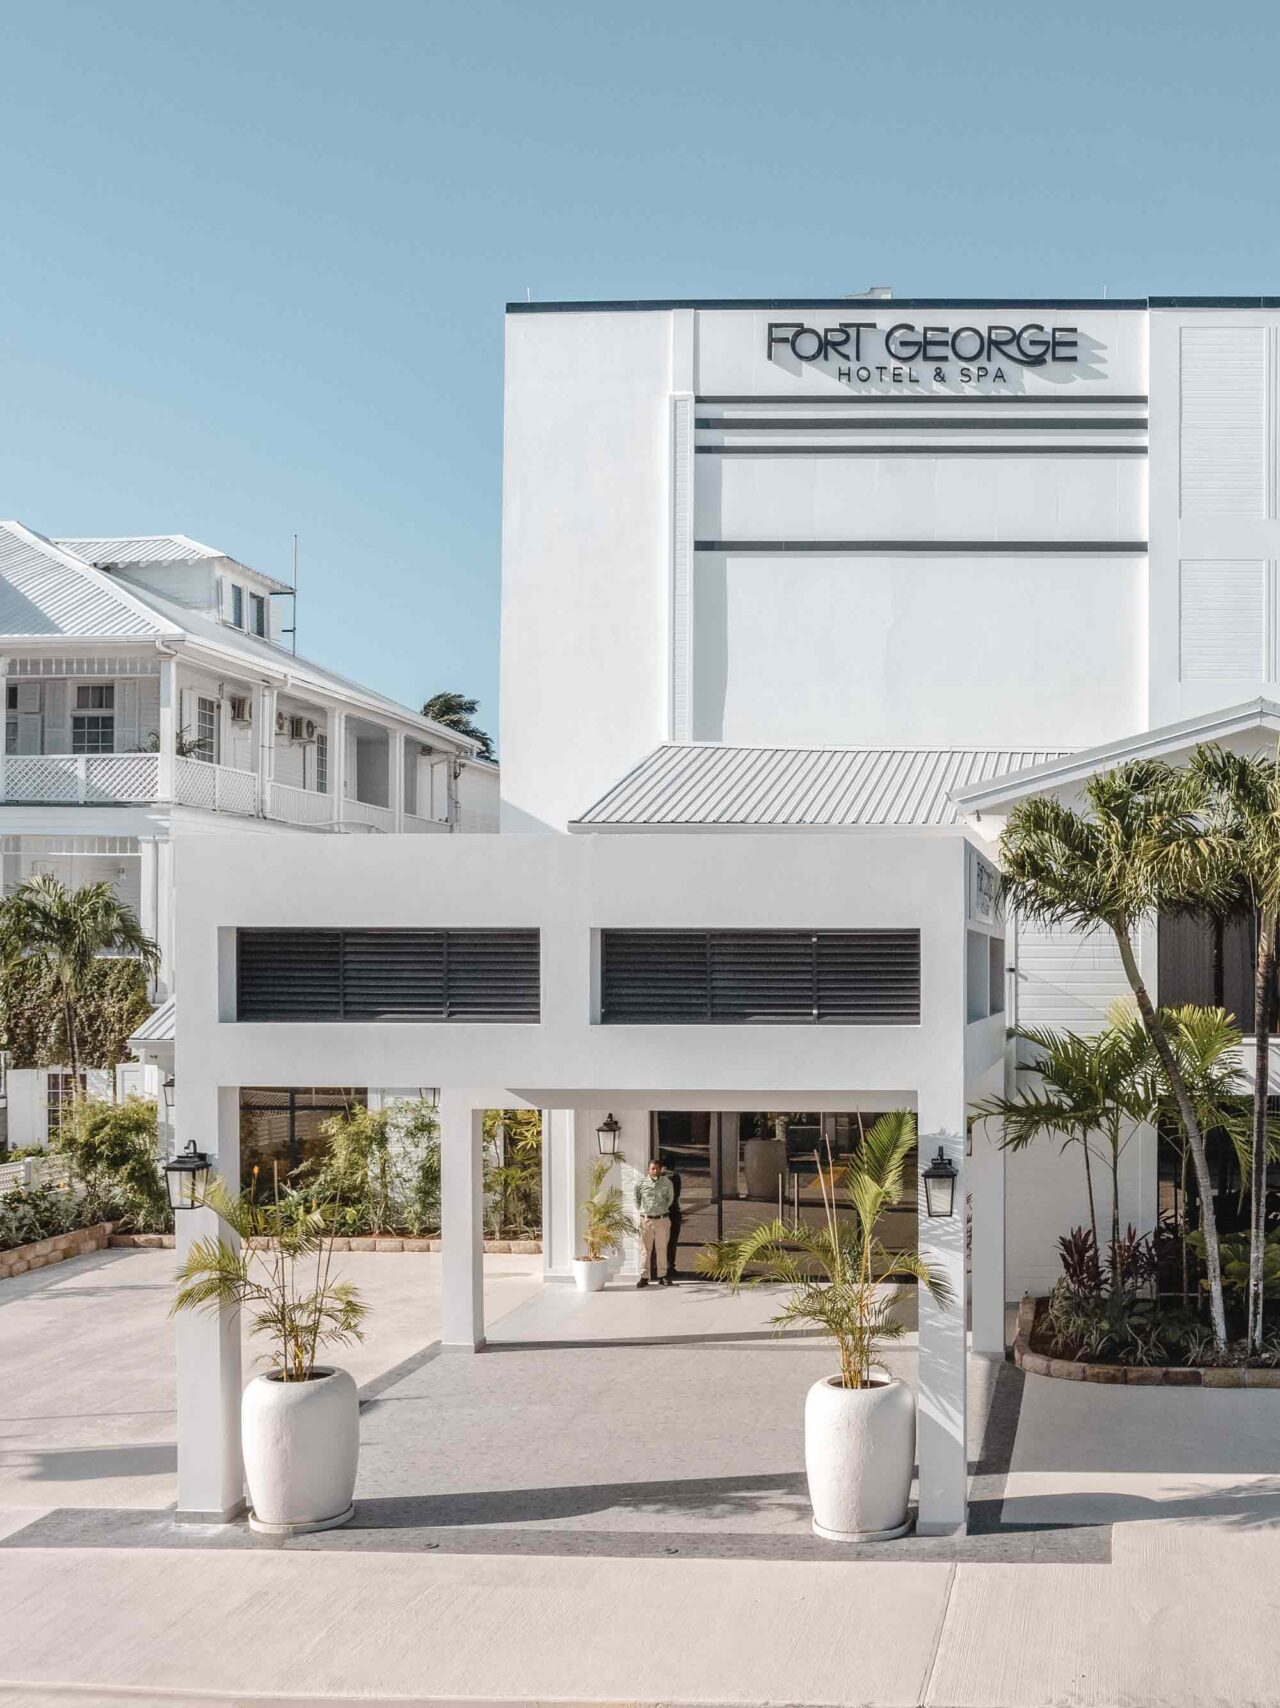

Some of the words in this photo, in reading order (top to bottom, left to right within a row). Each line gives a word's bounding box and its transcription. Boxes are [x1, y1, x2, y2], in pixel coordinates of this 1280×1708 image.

[767, 322, 877, 362] FORT
[885, 323, 1078, 367] GEORGE
[838, 367, 920, 383] HOTEL
[933, 367, 946, 383] &
[960, 367, 1007, 383] SPA
